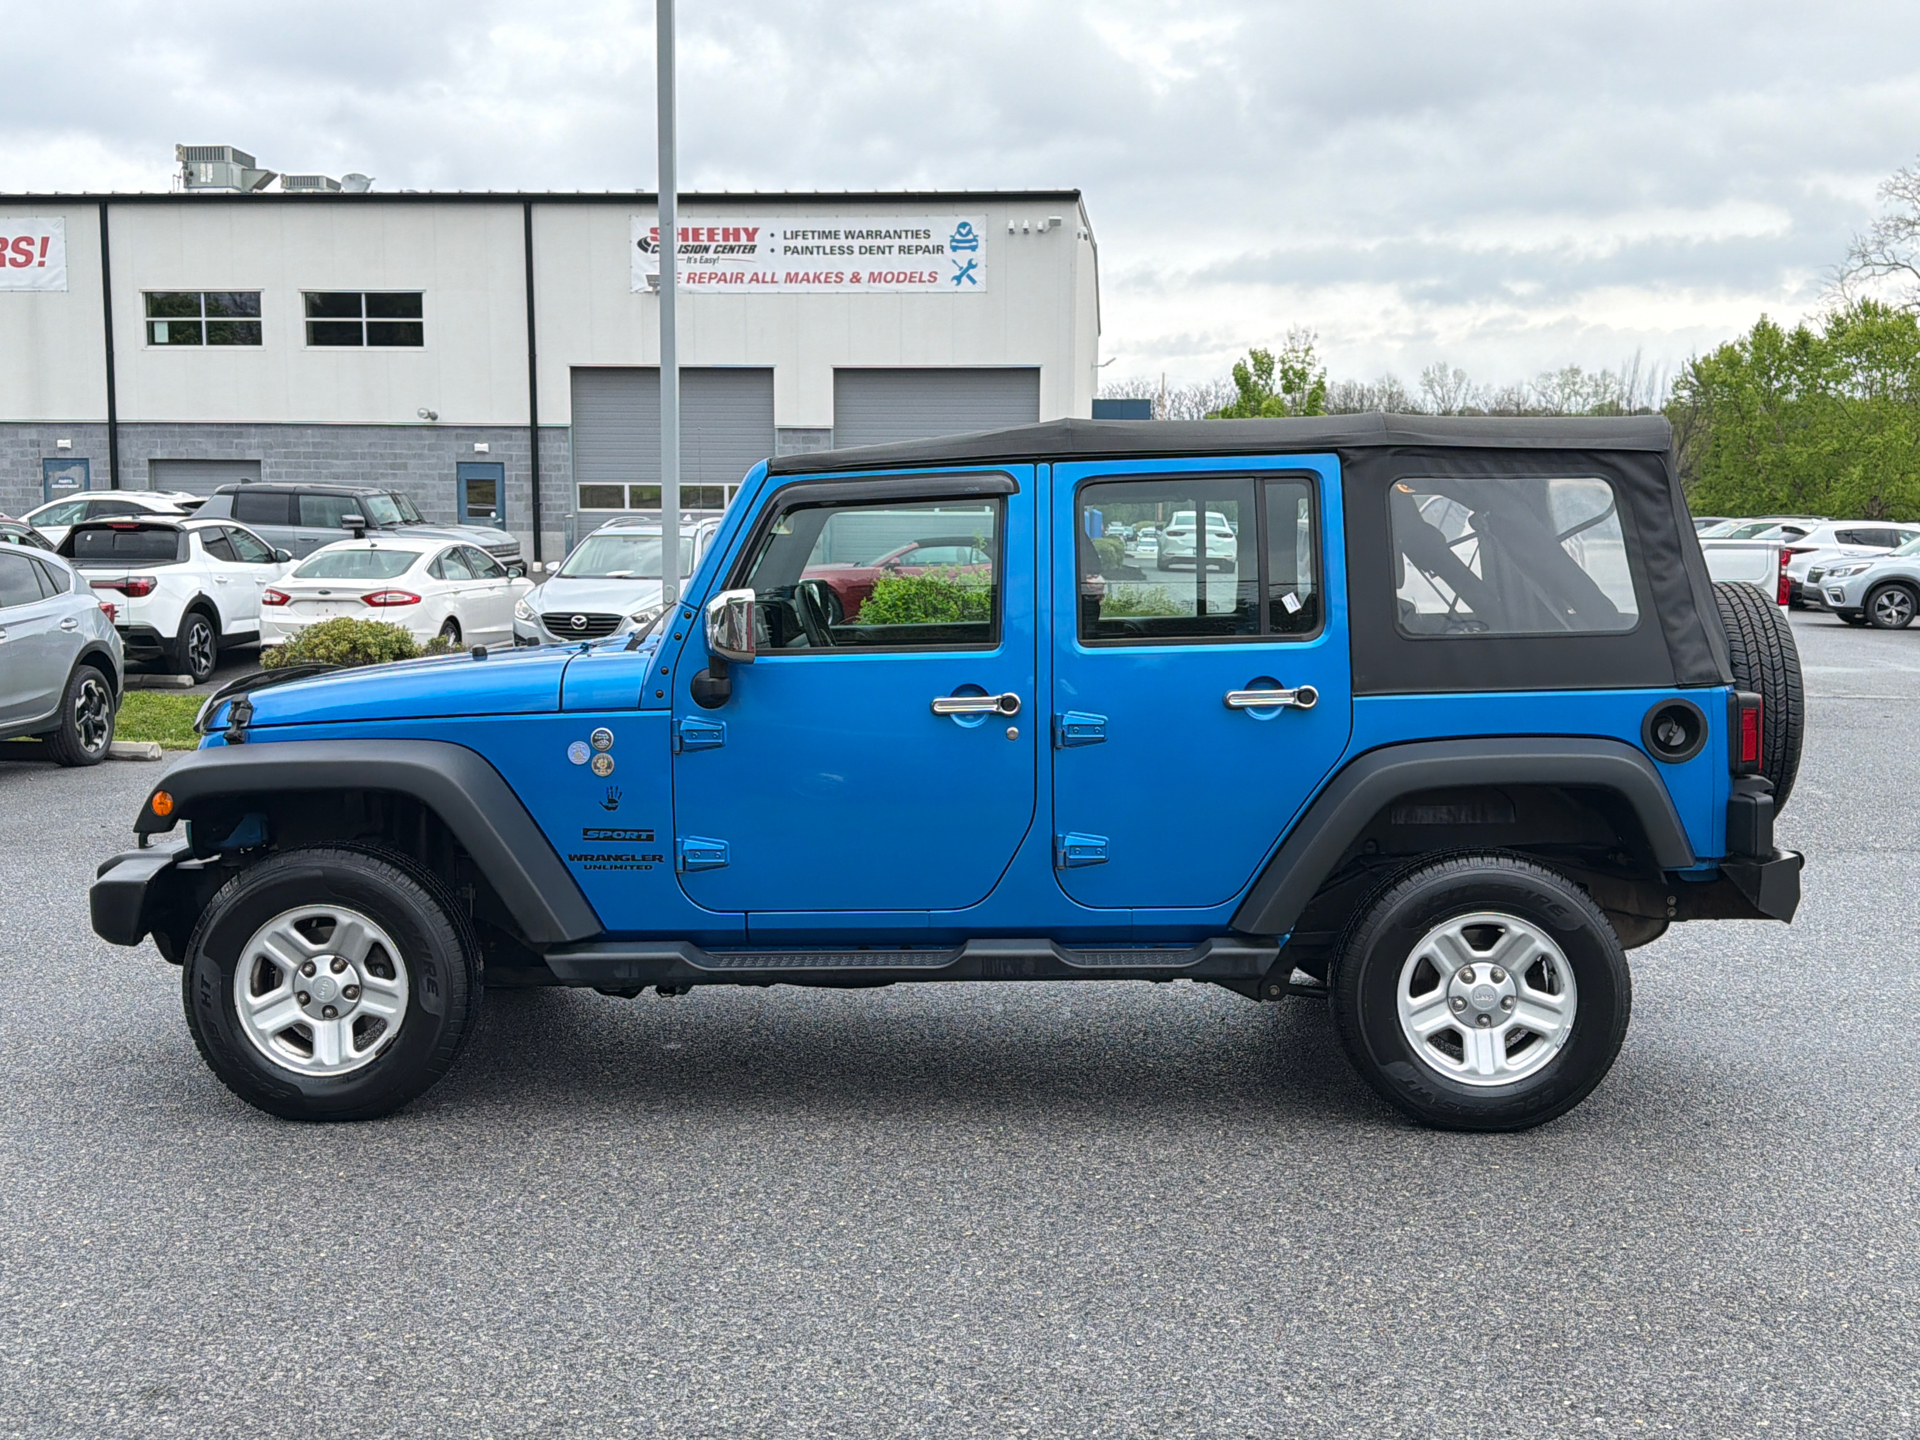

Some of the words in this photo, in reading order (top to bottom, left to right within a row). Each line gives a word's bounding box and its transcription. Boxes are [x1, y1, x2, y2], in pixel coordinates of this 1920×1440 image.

[783, 230, 841, 241] LIFETIME
[844, 229, 931, 240] WARRANTIES
[650, 244, 711, 254] CISION
[713, 244, 758, 254] CENTER
[783, 245, 855, 256] PAINTLESS
[858, 245, 894, 255] DENT
[898, 244, 945, 255] REPAIR
[686, 255, 697, 264] It's
[699, 255, 721, 266] Easy!
[686, 272, 746, 284] REPAIR
[748, 271, 779, 284] ALL
[784, 271, 845, 284] MAKES
[849, 271, 862, 284] &
[867, 270, 939, 284] MODELS
[583, 829, 655, 841] SPORT
[567, 853, 664, 863] WRANGLER
